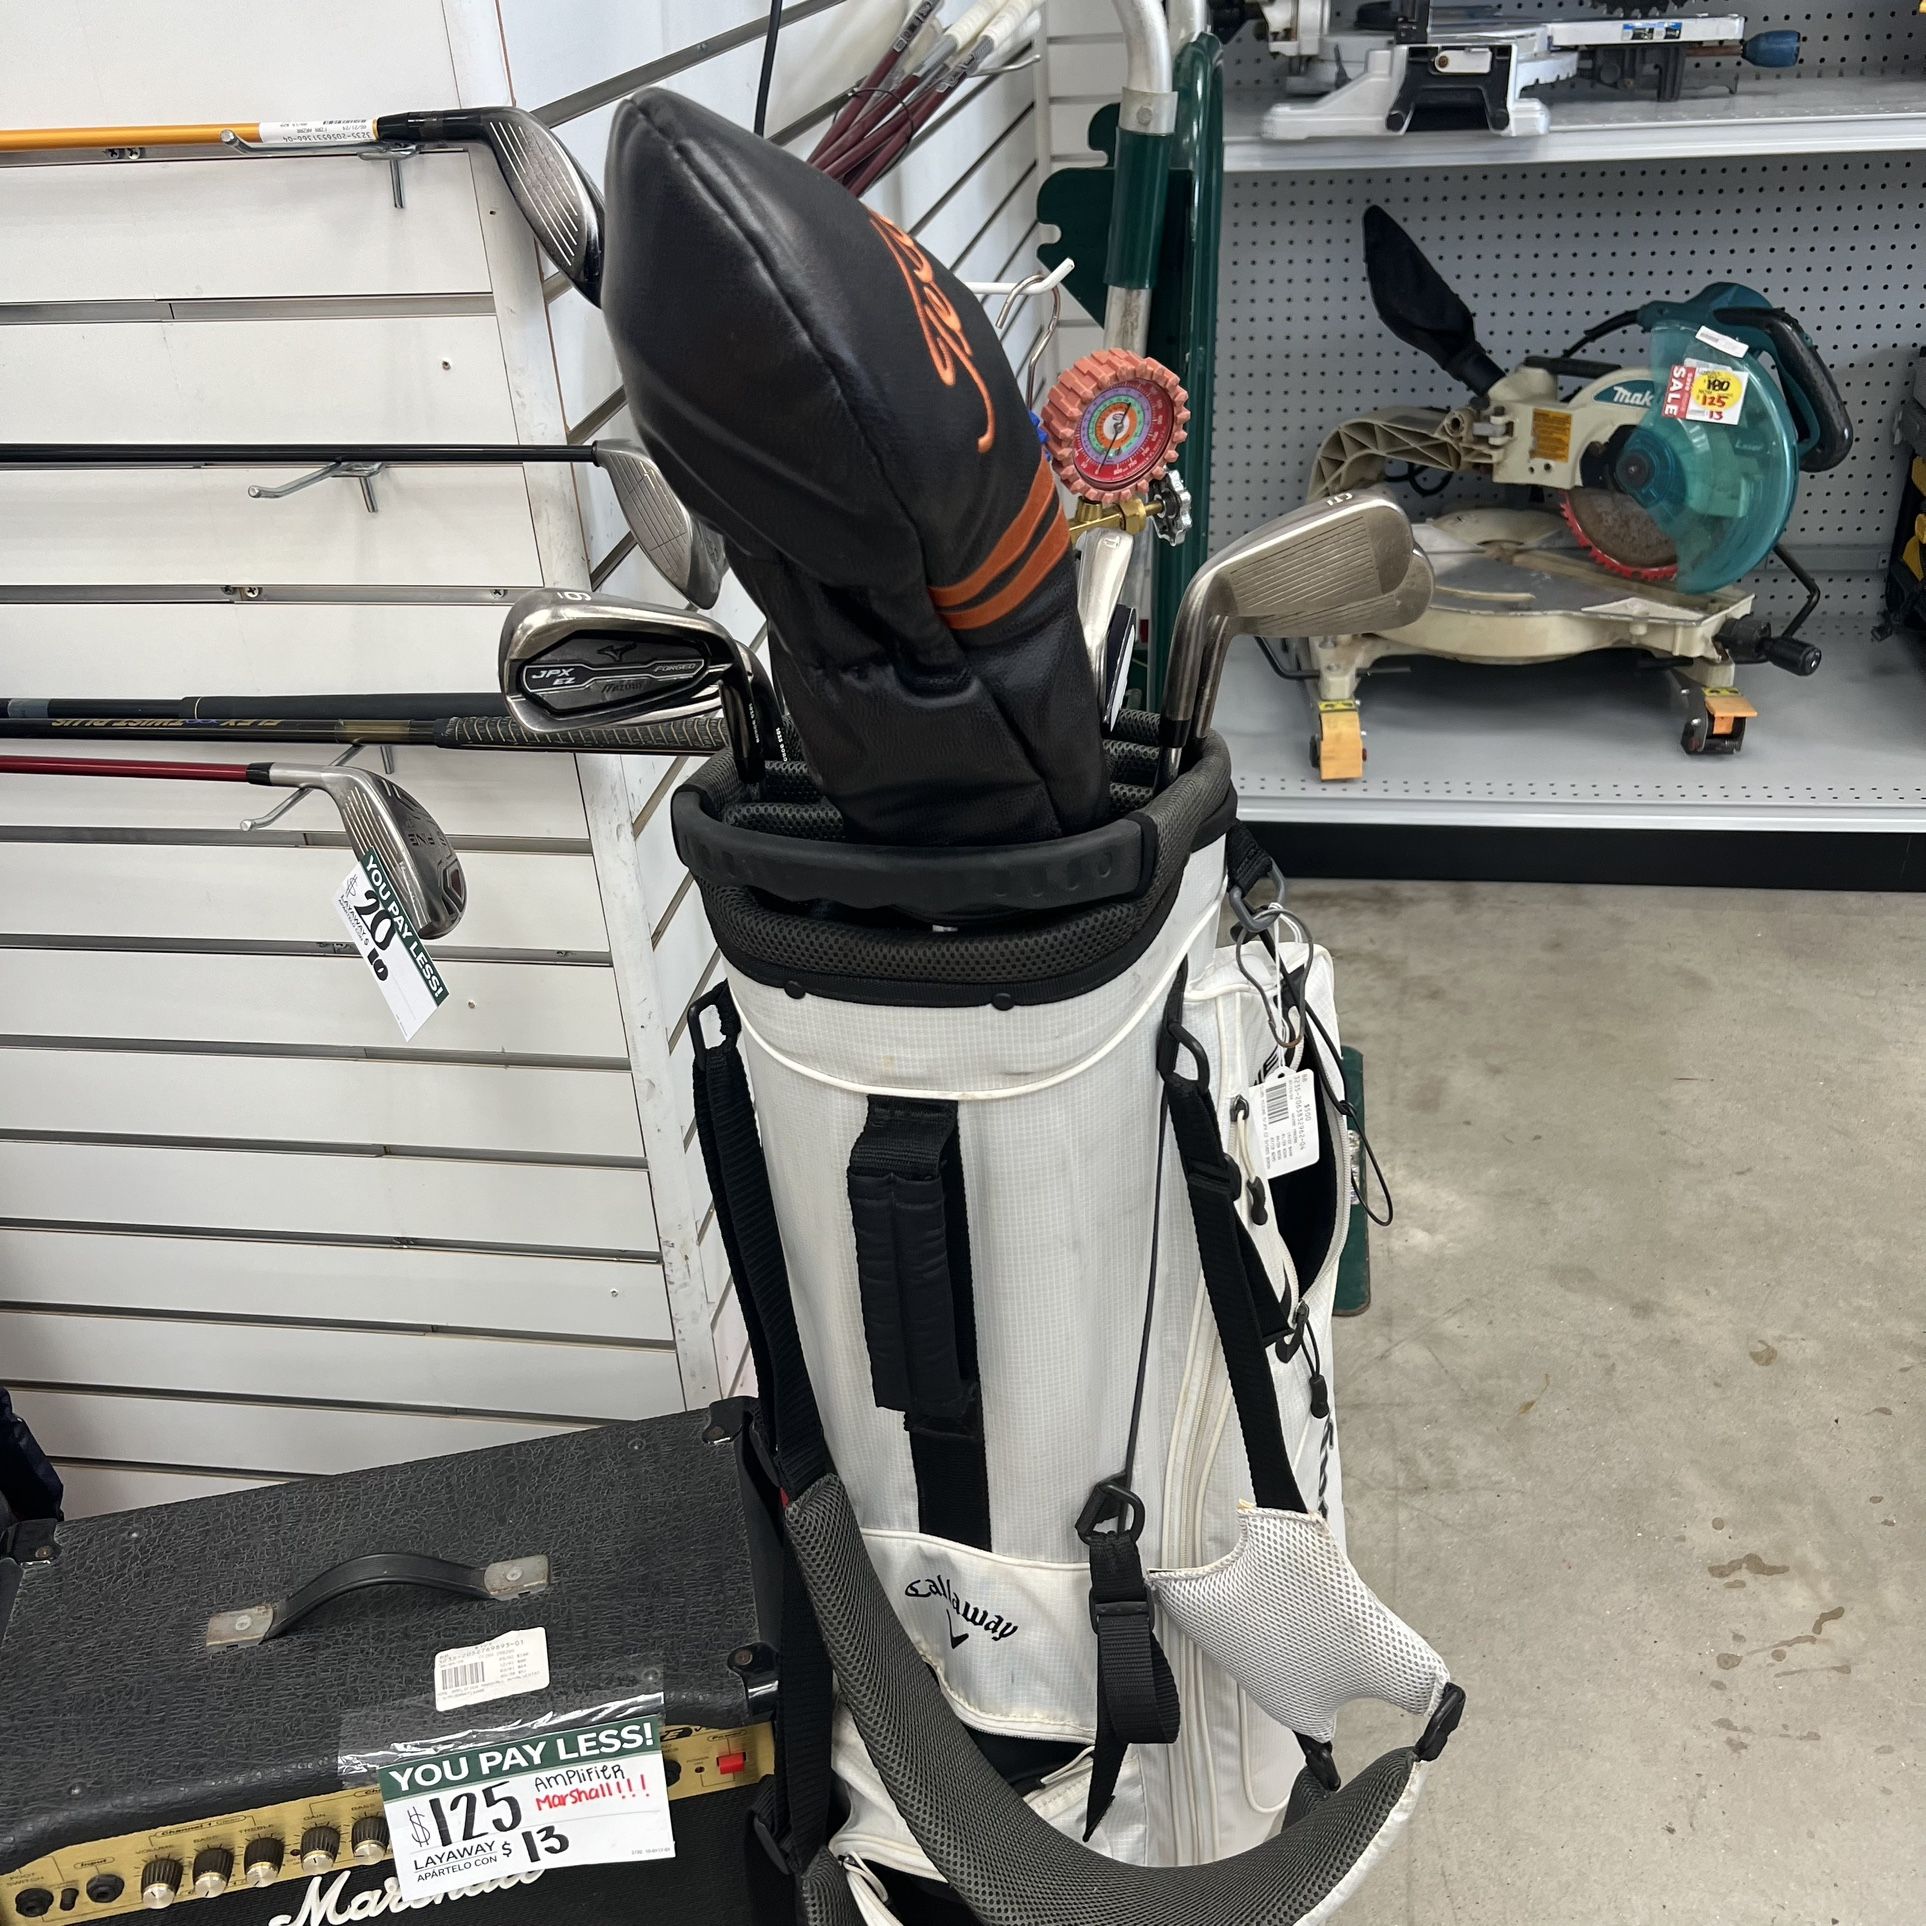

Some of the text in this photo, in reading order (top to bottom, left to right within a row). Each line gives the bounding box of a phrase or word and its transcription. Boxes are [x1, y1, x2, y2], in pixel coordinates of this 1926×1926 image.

[1665, 366, 1686, 416] SALE
[1701, 395, 1729, 407] 125
[531, 668, 575, 680] JPX
[552, 677, 576, 686] EZ
[366, 855, 444, 998] YOU PAY LESS!
[367, 947, 389, 981] 10
[905, 1575, 1018, 1641] Callaway
[389, 1722, 654, 1791] YOU PAY LESS!
[413, 1840, 496, 1870] LAYAWAY
[521, 1825, 570, 1862] 13
[417, 1855, 498, 1883] APÁRTELO CON
